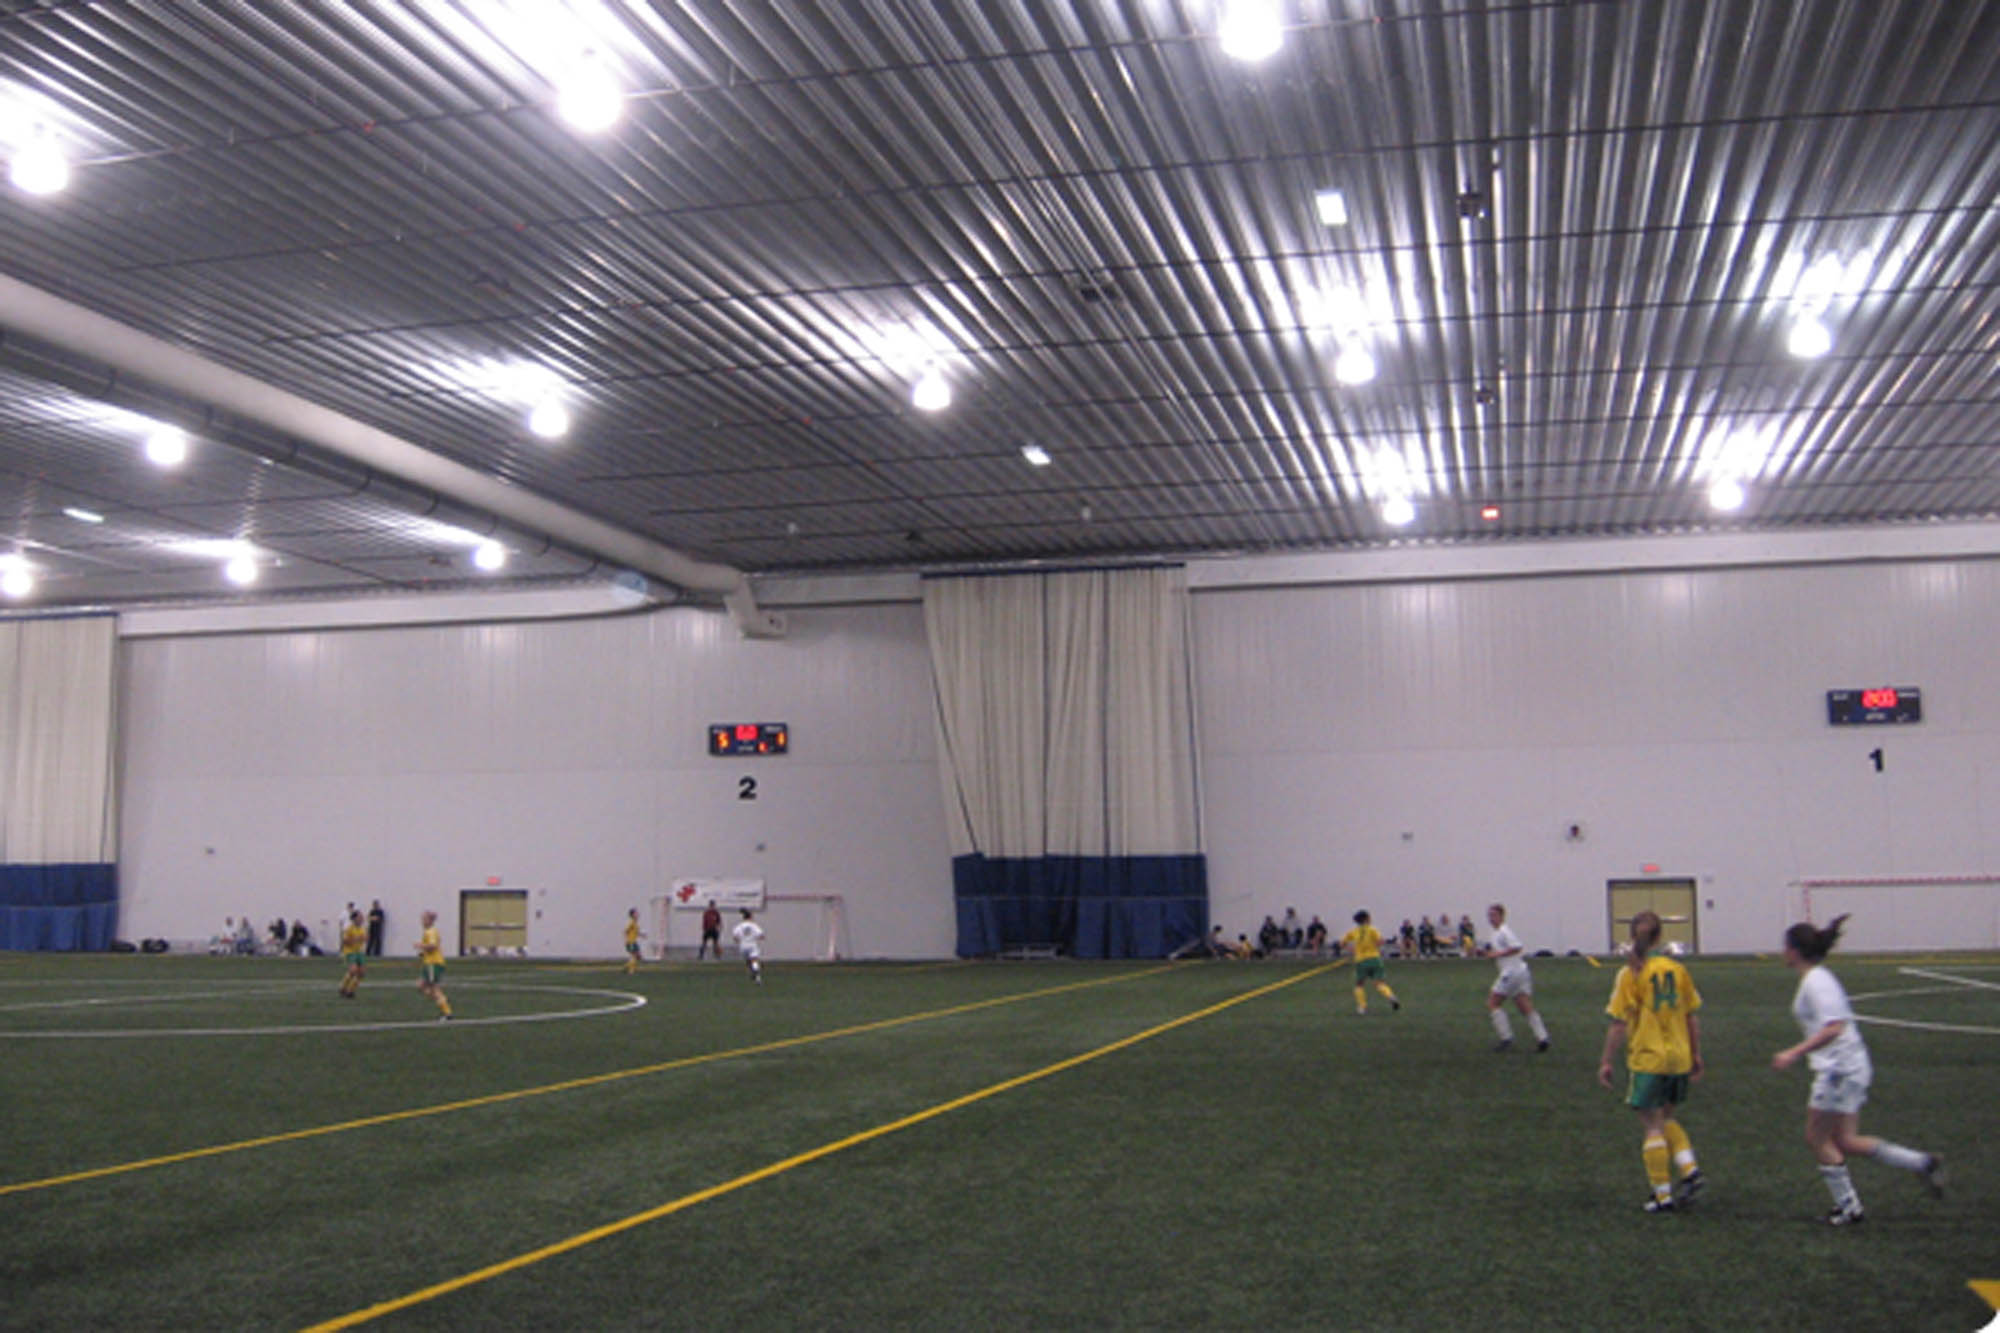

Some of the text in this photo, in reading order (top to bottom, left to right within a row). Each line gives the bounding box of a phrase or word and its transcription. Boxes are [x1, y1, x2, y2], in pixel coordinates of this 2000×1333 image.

[1869, 749, 1883, 772] 1
[739, 776, 757, 800] 2
[1649, 970, 1677, 1011] 14
